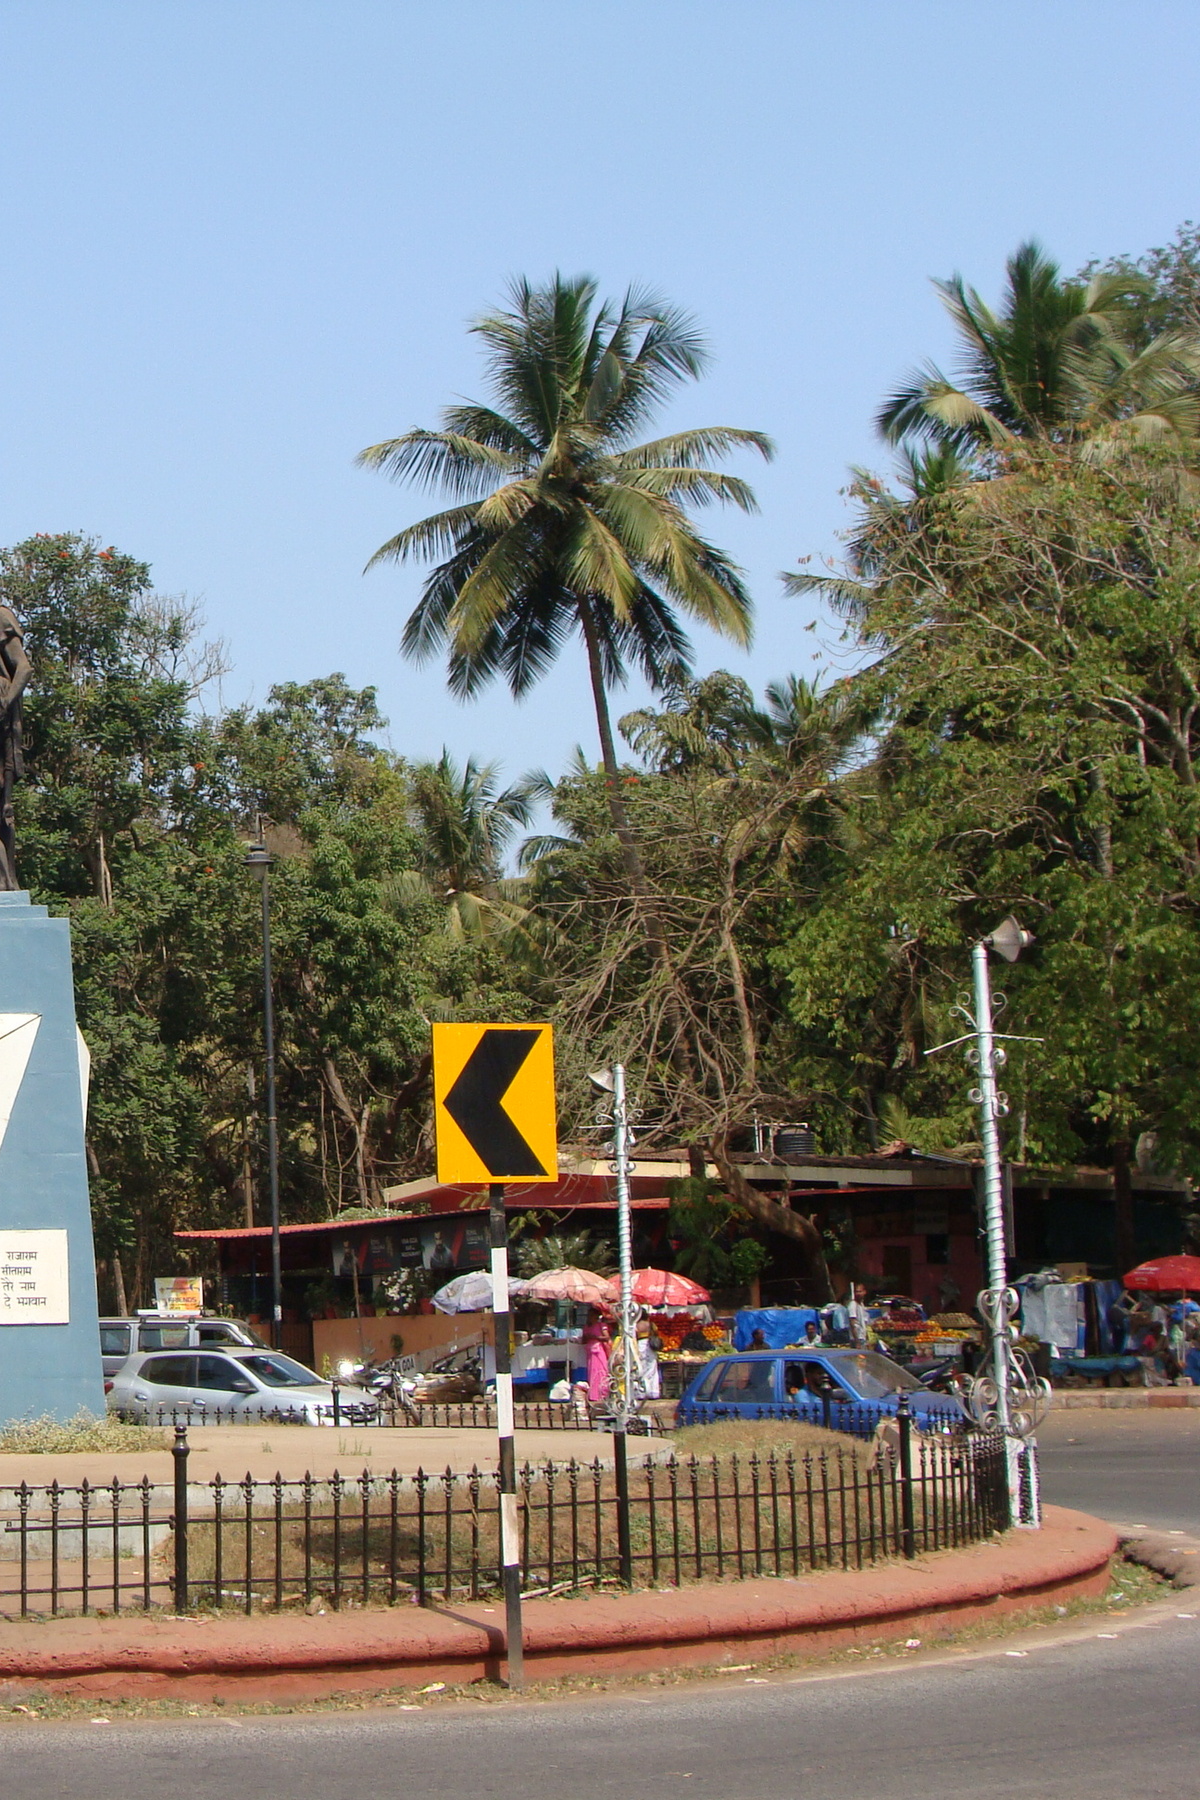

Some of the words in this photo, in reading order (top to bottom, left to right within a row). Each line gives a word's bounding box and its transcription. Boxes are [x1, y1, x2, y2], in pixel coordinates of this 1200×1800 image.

[6, 1251, 38, 1261] राजाराम
[1, 1264, 32, 1276] सीताराम
[0, 1276, 14, 1292] तेरे
[19, 1281, 36, 1291] नाम
[3, 1293, 11, 1309] दे
[17, 1297, 47, 1307] भगवान
